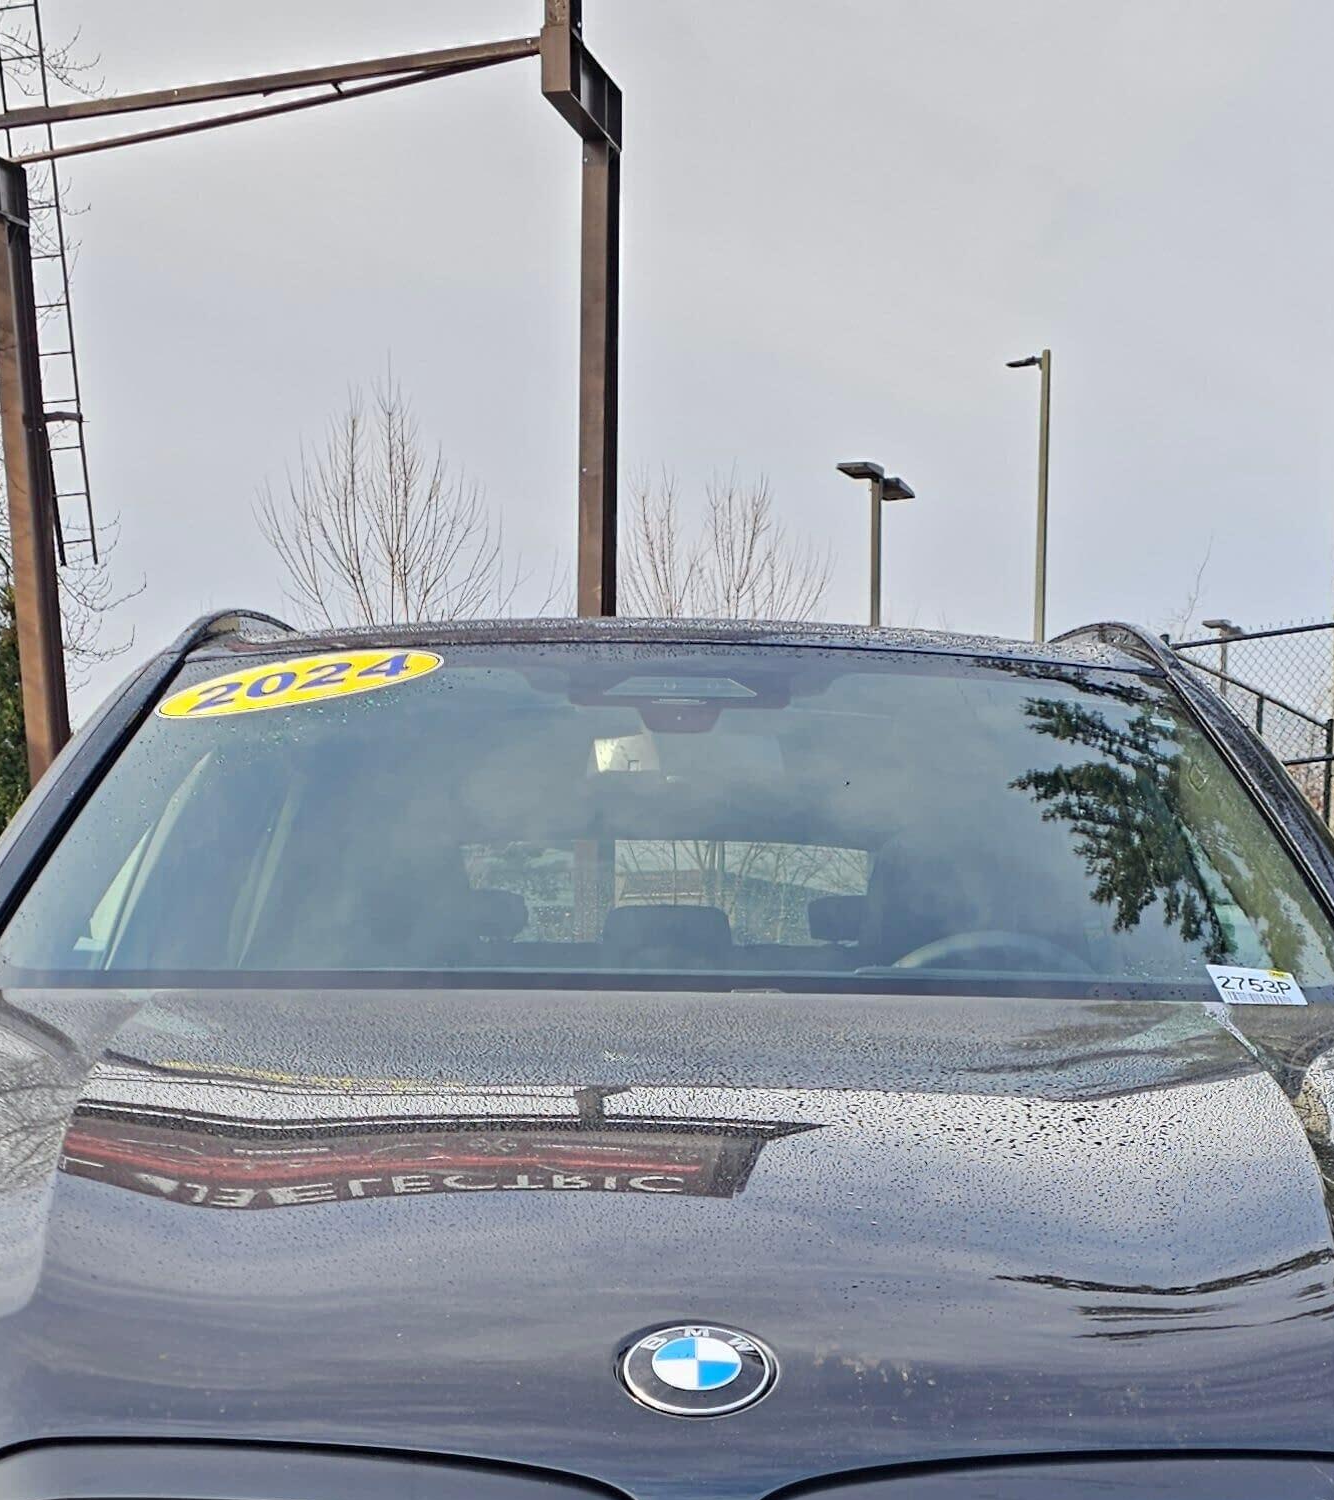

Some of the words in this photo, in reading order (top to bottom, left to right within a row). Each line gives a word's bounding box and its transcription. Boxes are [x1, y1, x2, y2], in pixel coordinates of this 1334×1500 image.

[185, 653, 412, 713] 2024
[1217, 976, 1292, 994] 2753P
[639, 1327, 756, 1352] BMW
